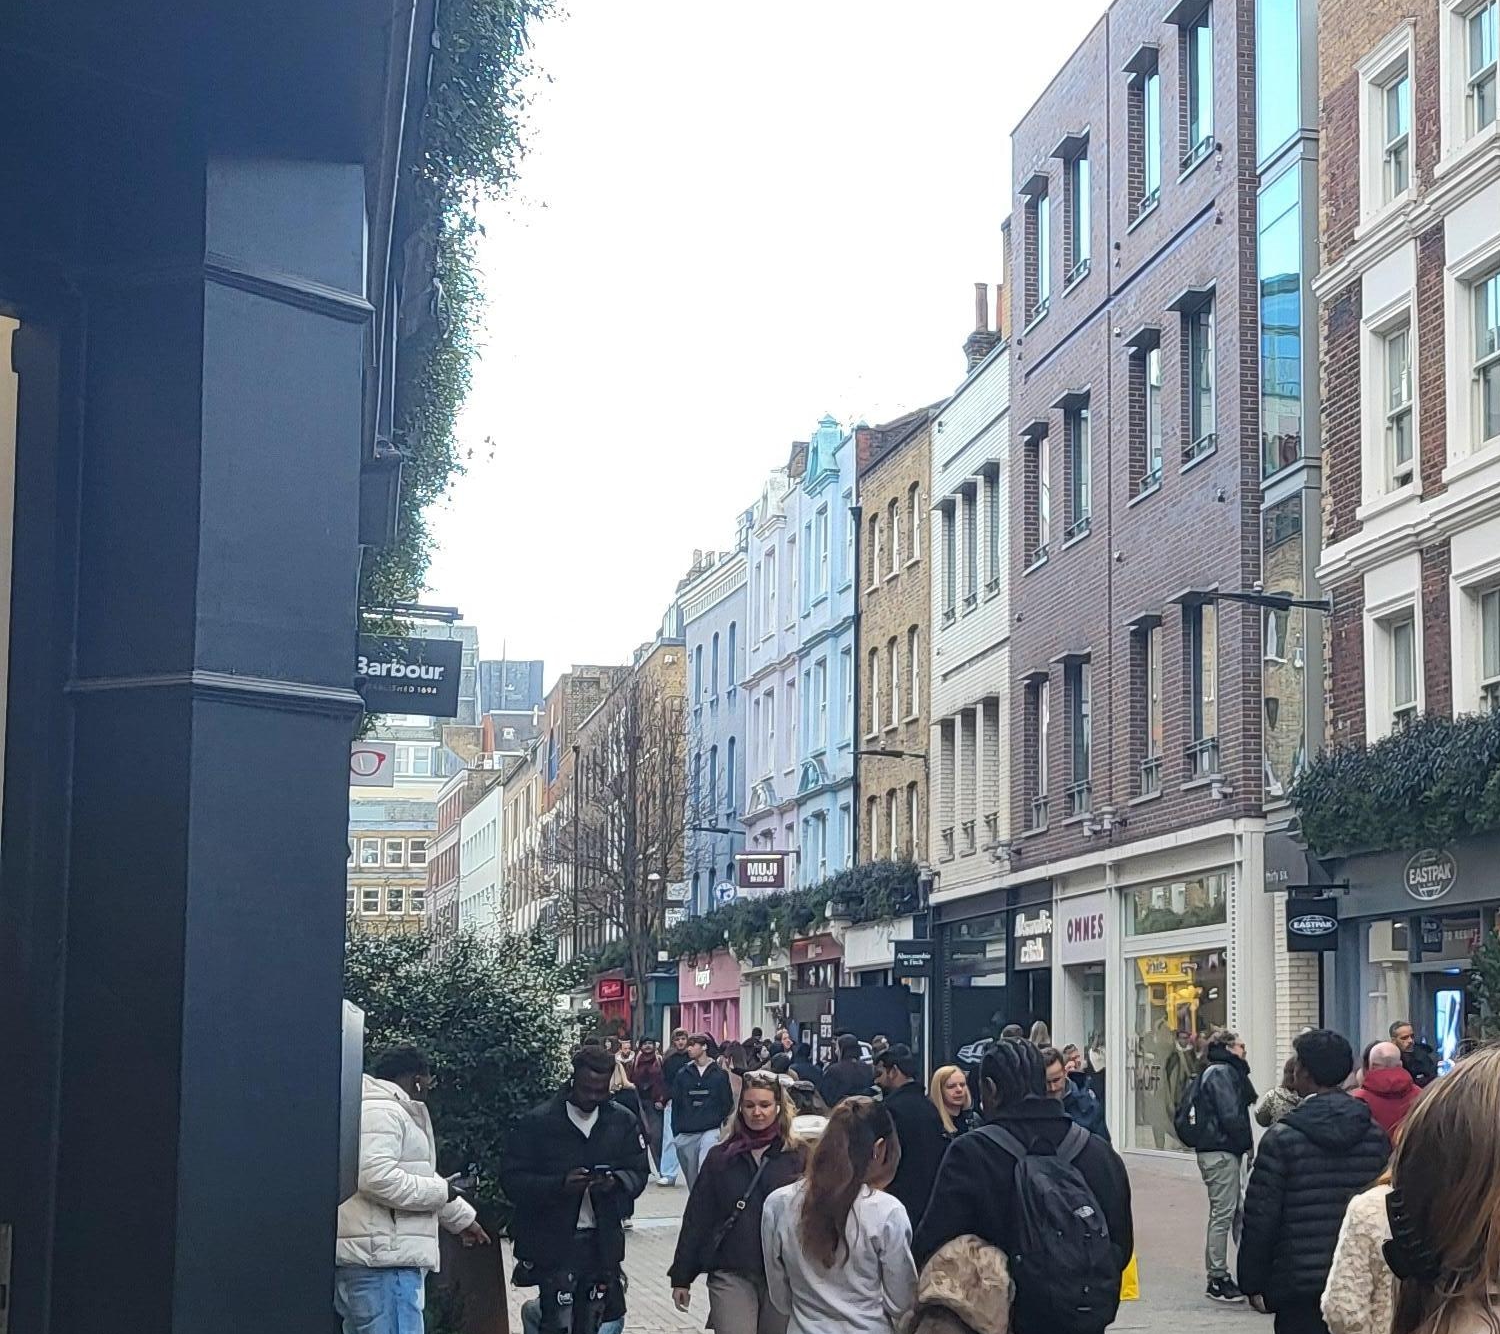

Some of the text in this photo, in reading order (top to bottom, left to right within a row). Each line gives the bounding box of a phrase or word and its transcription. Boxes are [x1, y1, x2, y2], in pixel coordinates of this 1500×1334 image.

[357, 655, 444, 681] Barbour
[747, 862, 778, 876] MUJI
[1410, 863, 1451, 885] EASTPAK
[1067, 913, 1104, 944] OMNES
[1293, 921, 1333, 929] EASTPAK
